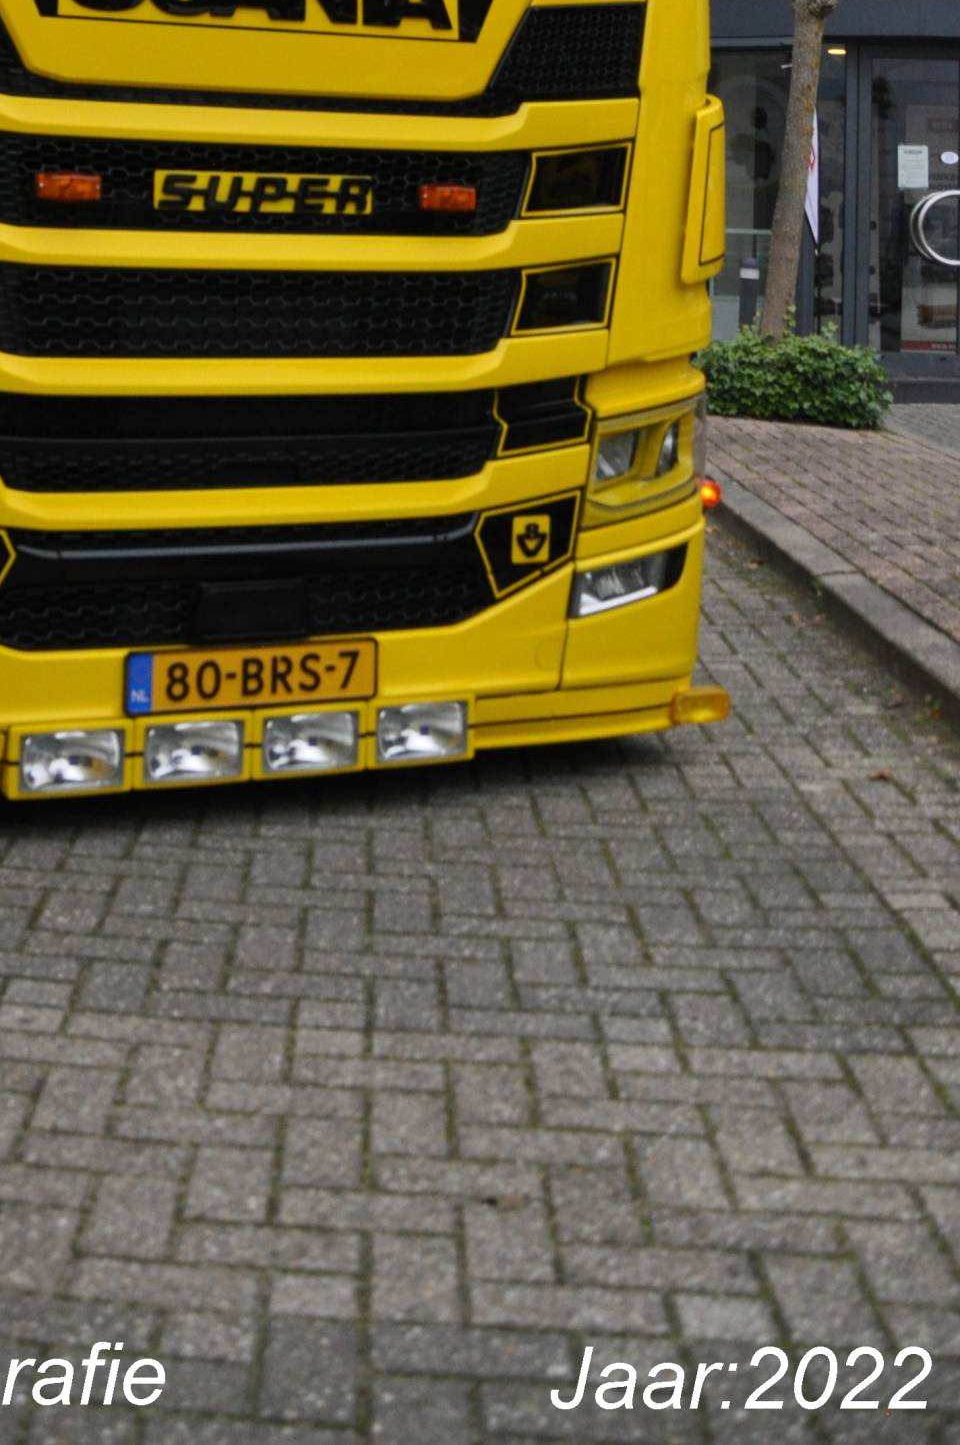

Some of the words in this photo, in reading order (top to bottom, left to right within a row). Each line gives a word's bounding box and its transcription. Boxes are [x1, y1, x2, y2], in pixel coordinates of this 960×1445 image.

[158, 173, 372, 214] SUPER
[130, 689, 149, 704] NL
[165, 649, 360, 703] 80-BRS-7
